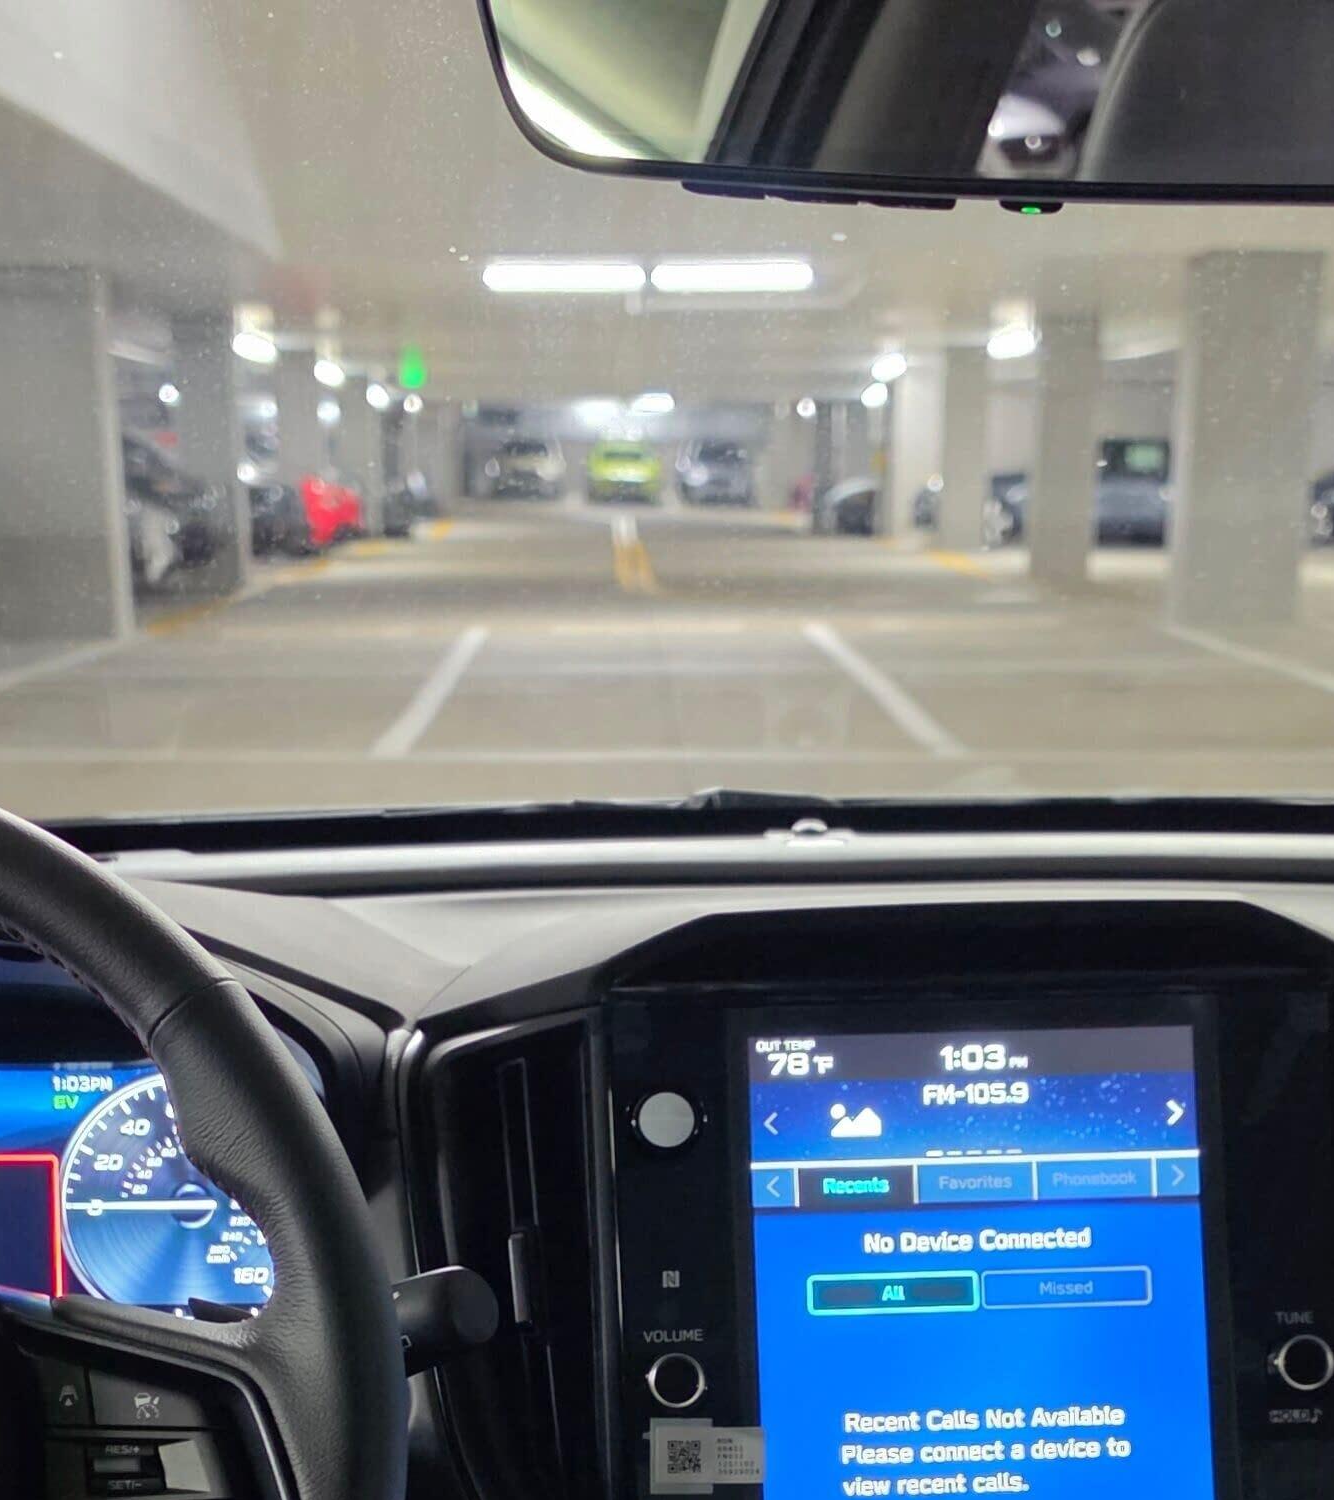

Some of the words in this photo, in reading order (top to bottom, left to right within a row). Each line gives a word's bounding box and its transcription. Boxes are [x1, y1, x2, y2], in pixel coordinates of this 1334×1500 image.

[755, 1040, 782, 1053] OUT
[939, 1044, 1008, 1071] 1:03
[923, 1081, 1029, 1106] FM-105.9
[120, 1118, 150, 1136] 40
[94, 1154, 123, 1171] 20
[822, 1176, 890, 1195] Recents
[938, 1173, 1012, 1190] Favorites
[1052, 1169, 1137, 1187] Phonebook
[863, 1232, 894, 1255] No
[899, 1230, 973, 1253] Device
[979, 1226, 1092, 1251] Connected
[233, 1267, 269, 1284] 160
[881, 1285, 905, 1301] All
[1039, 1280, 1094, 1296] Missed
[1275, 1311, 1315, 1324] TUNE
[643, 1328, 704, 1343] VOLUME
[844, 1410, 921, 1435] Recent
[925, 1408, 980, 1432] Calls
[985, 1407, 1026, 1430] Not
[1030, 1404, 1126, 1428] Available
[840, 1443, 914, 1465] Please
[920, 1440, 1004, 1463] connect
[1010, 1444, 1025, 1461] a
[1029, 1438, 1101, 1460] device
[1106, 1437, 1131, 1457] to
[842, 1476, 892, 1497] view
[896, 1474, 967, 1495] recent
[972, 1472, 1030, 1493] calls.
